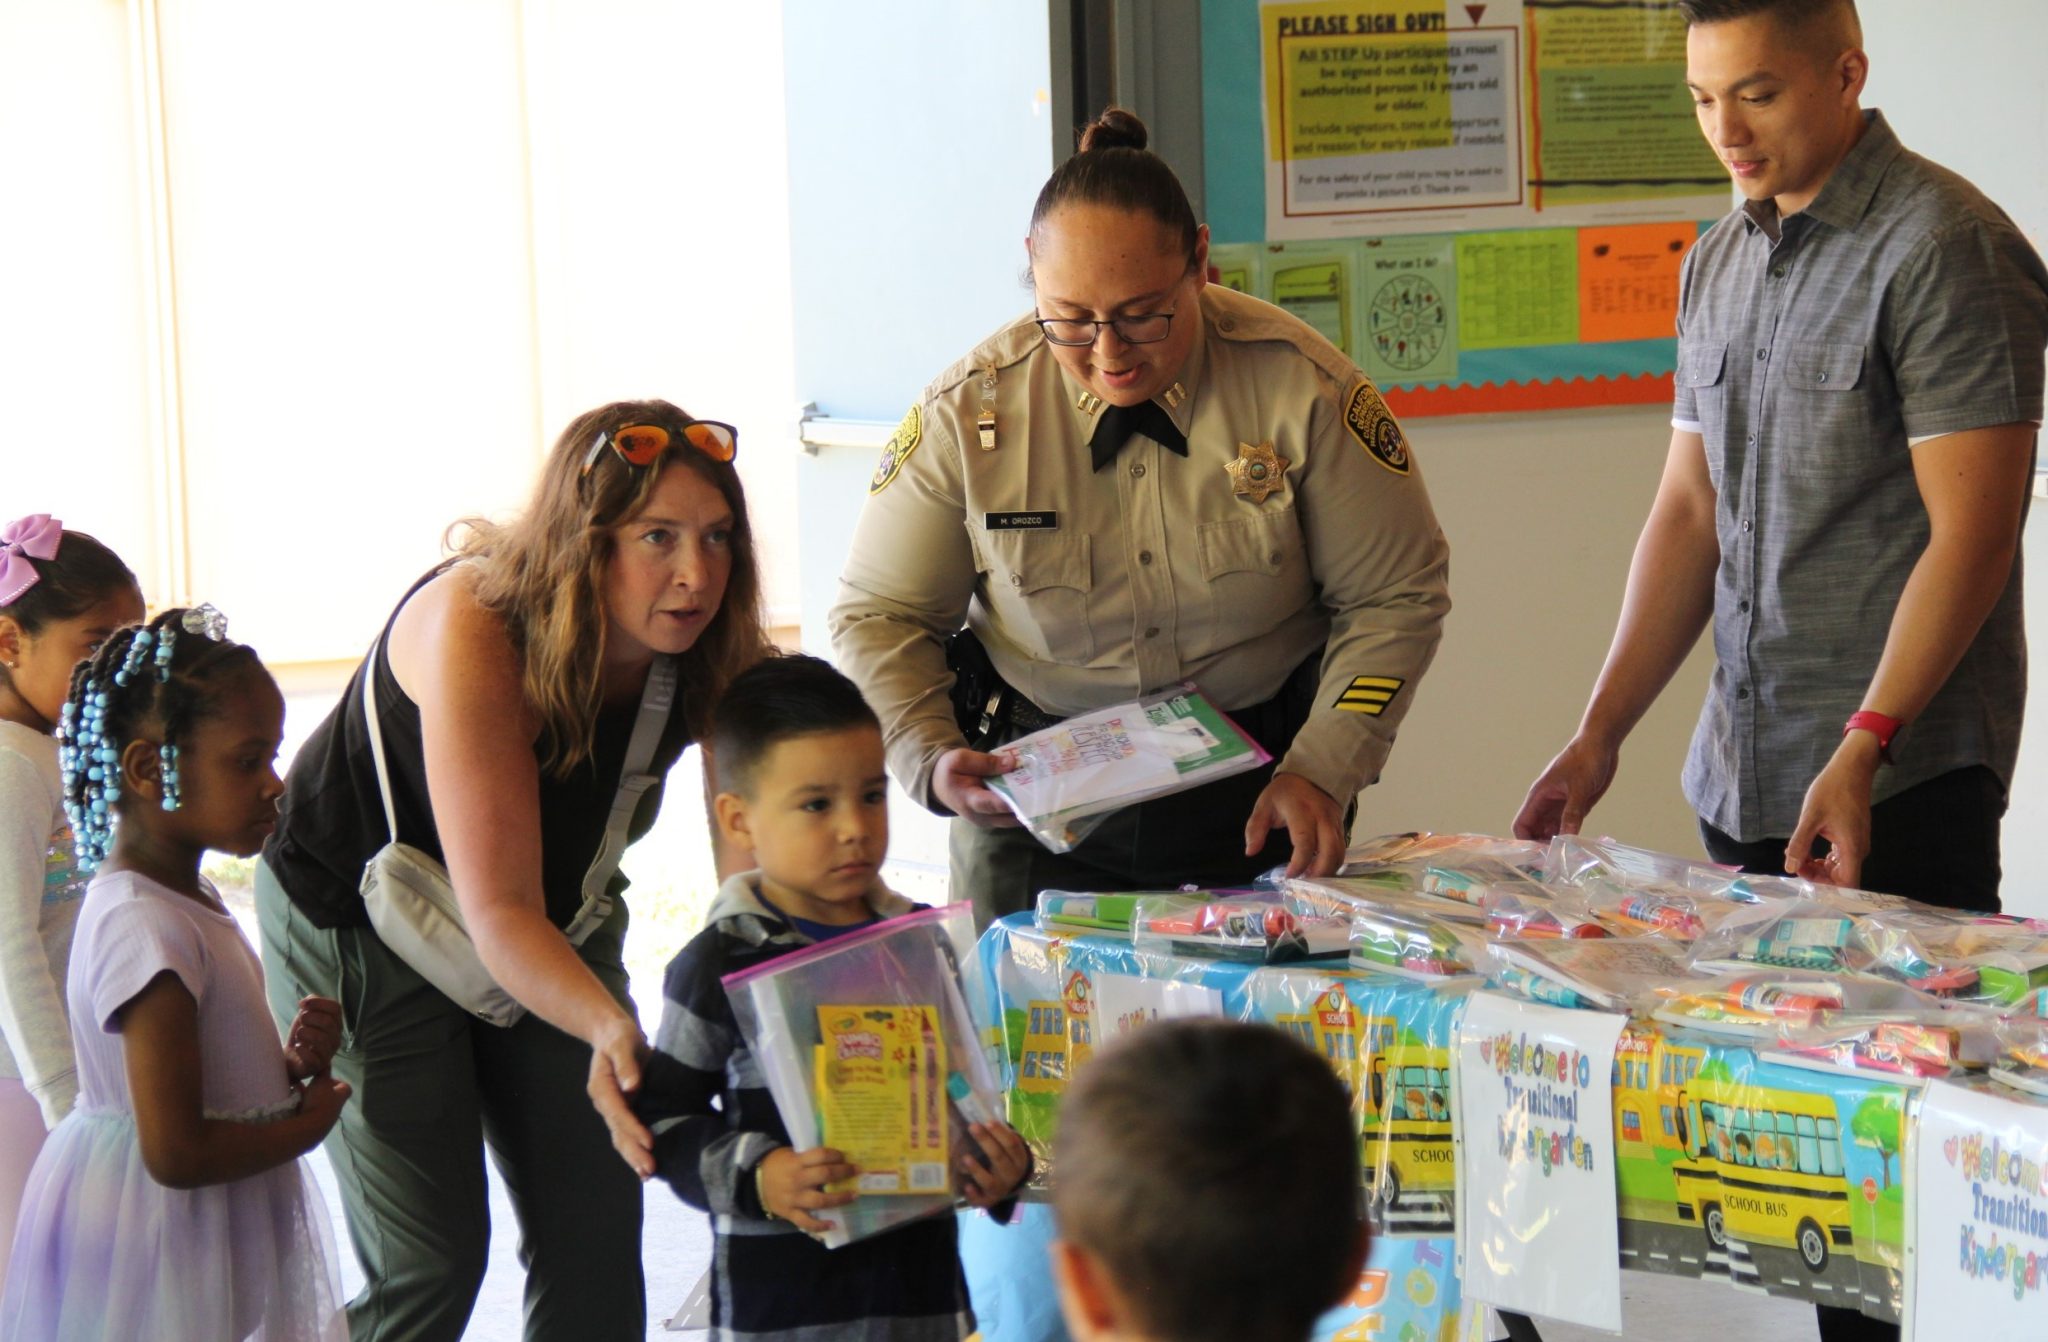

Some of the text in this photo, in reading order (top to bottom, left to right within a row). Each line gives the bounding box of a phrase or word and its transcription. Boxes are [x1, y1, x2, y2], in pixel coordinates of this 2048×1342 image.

[1278, 12, 1446, 35] PLEASE SIGN OUT!
[1299, 44, 1498, 62] All STEP Up participants must
[1320, 62, 1478, 81] be signed out daily by an
[1300, 84, 1372, 97] authorized
[1375, 82, 1418, 97] person
[1440, 79, 1475, 94] years
[1478, 78, 1499, 90] old
[1374, 102, 1389, 112] or
[1299, 123, 1342, 136] Include
[1401, 119, 1426, 132] time
[1429, 118, 1444, 130] of
[1446, 116, 1500, 133] departure
[1294, 142, 1314, 154] and
[1318, 140, 1356, 152] reason
[1360, 138, 1377, 151] for
[1381, 138, 1407, 153] early
[1410, 135, 1450, 148] release
[1452, 133, 1461, 145] if
[1298, 173, 1314, 185] For
[1316, 172, 1332, 184] the
[1334, 171, 1360, 187] safety
[1362, 170, 1373, 182] of
[1374, 171, 1393, 184] your
[1396, 168, 1416, 181] child
[1418, 169, 1433, 182] you
[1454, 167, 1465, 178] be
[1468, 166, 1491, 177] asked
[1493, 166, 1504, 176] to
[1334, 187, 1368, 201] provide
[1377, 185, 1409, 200] picture
[1425, 183, 1451, 195] Thank
[1375, 259, 1397, 270] What
[1399, 260, 1413, 270] can
[1423, 257, 1439, 268] do?
[1011, 517, 1042, 525] OROZCO
[1494, 1030, 1590, 1089] Welcome to
[1497, 1114, 1594, 1178] Kergarten
[1723, 1193, 1788, 1219] SCHOOL BUS
